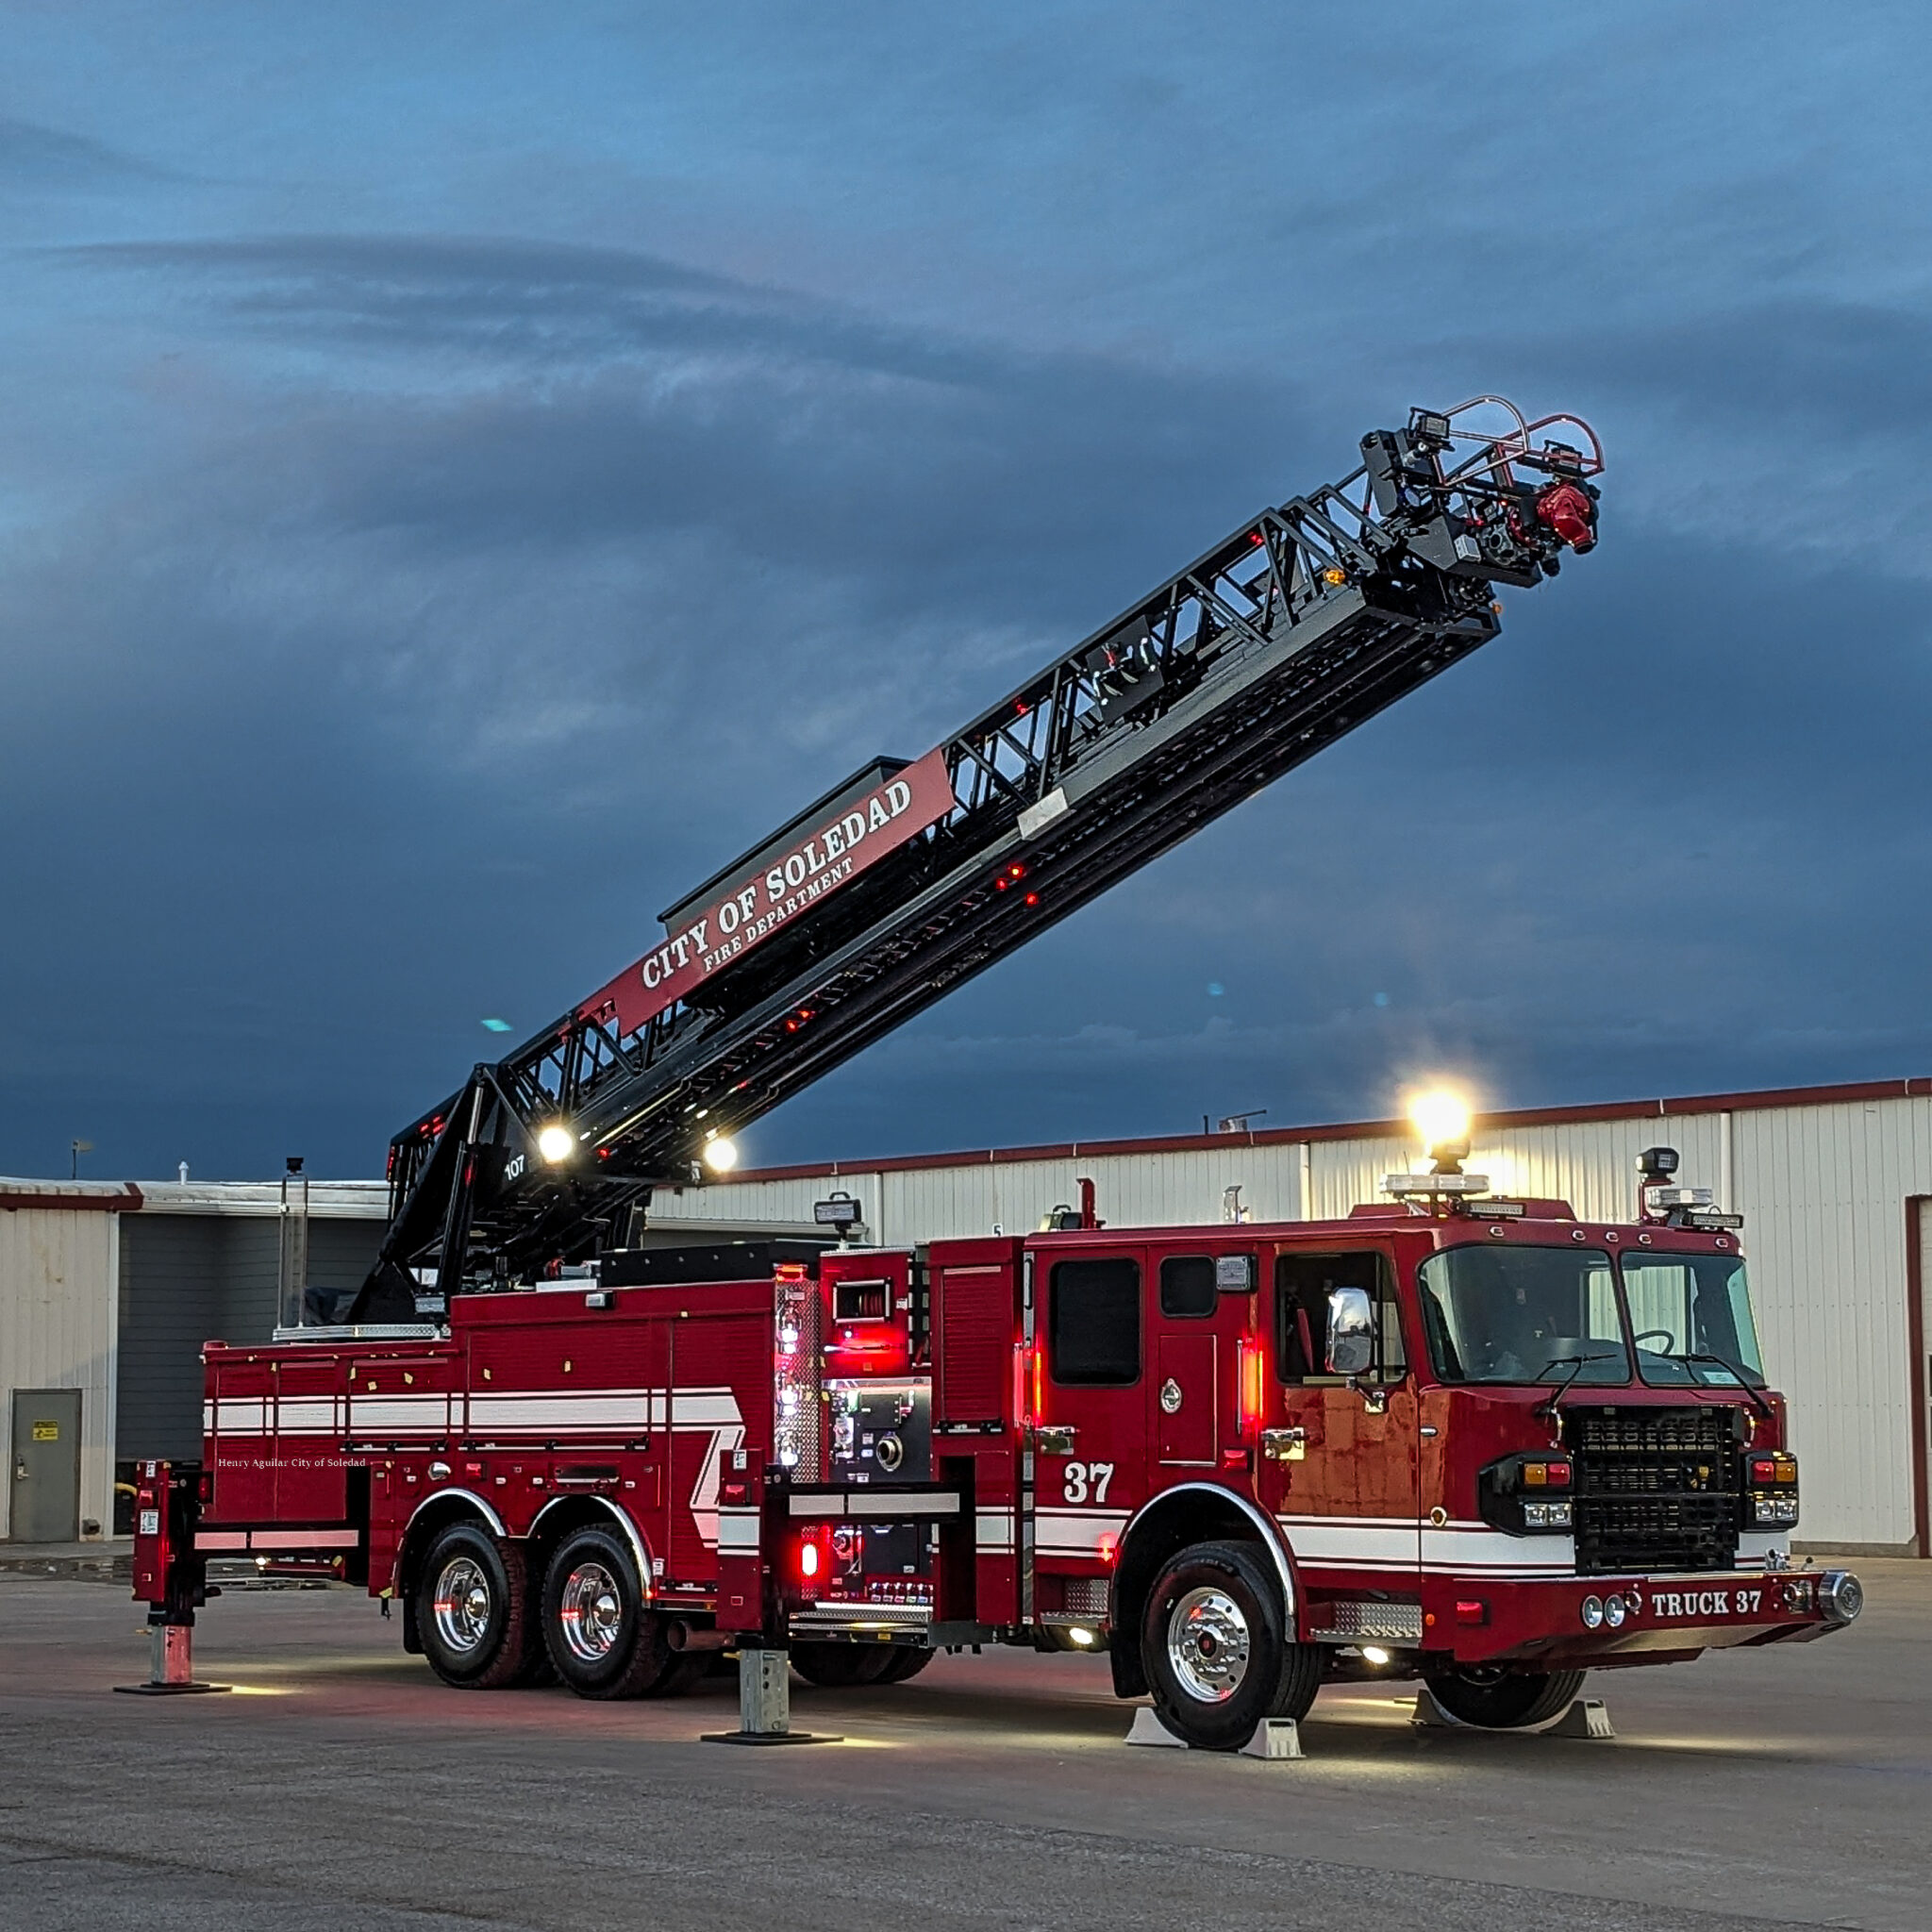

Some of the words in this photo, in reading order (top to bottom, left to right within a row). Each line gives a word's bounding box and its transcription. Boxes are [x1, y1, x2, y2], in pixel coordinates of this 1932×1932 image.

[642, 919, 709, 989] CITY
[718, 885, 758, 935] OF
[765, 779, 912, 903] SOLEDAD
[702, 940, 742, 974] FIRE
[745, 858, 854, 944] DEPARTMENT
[504, 1154, 525, 1181] 107
[1063, 1461, 1114, 1503] 37
[1652, 1591, 1729, 1616] TRUCK
[1736, 1591, 1761, 1613] 37
